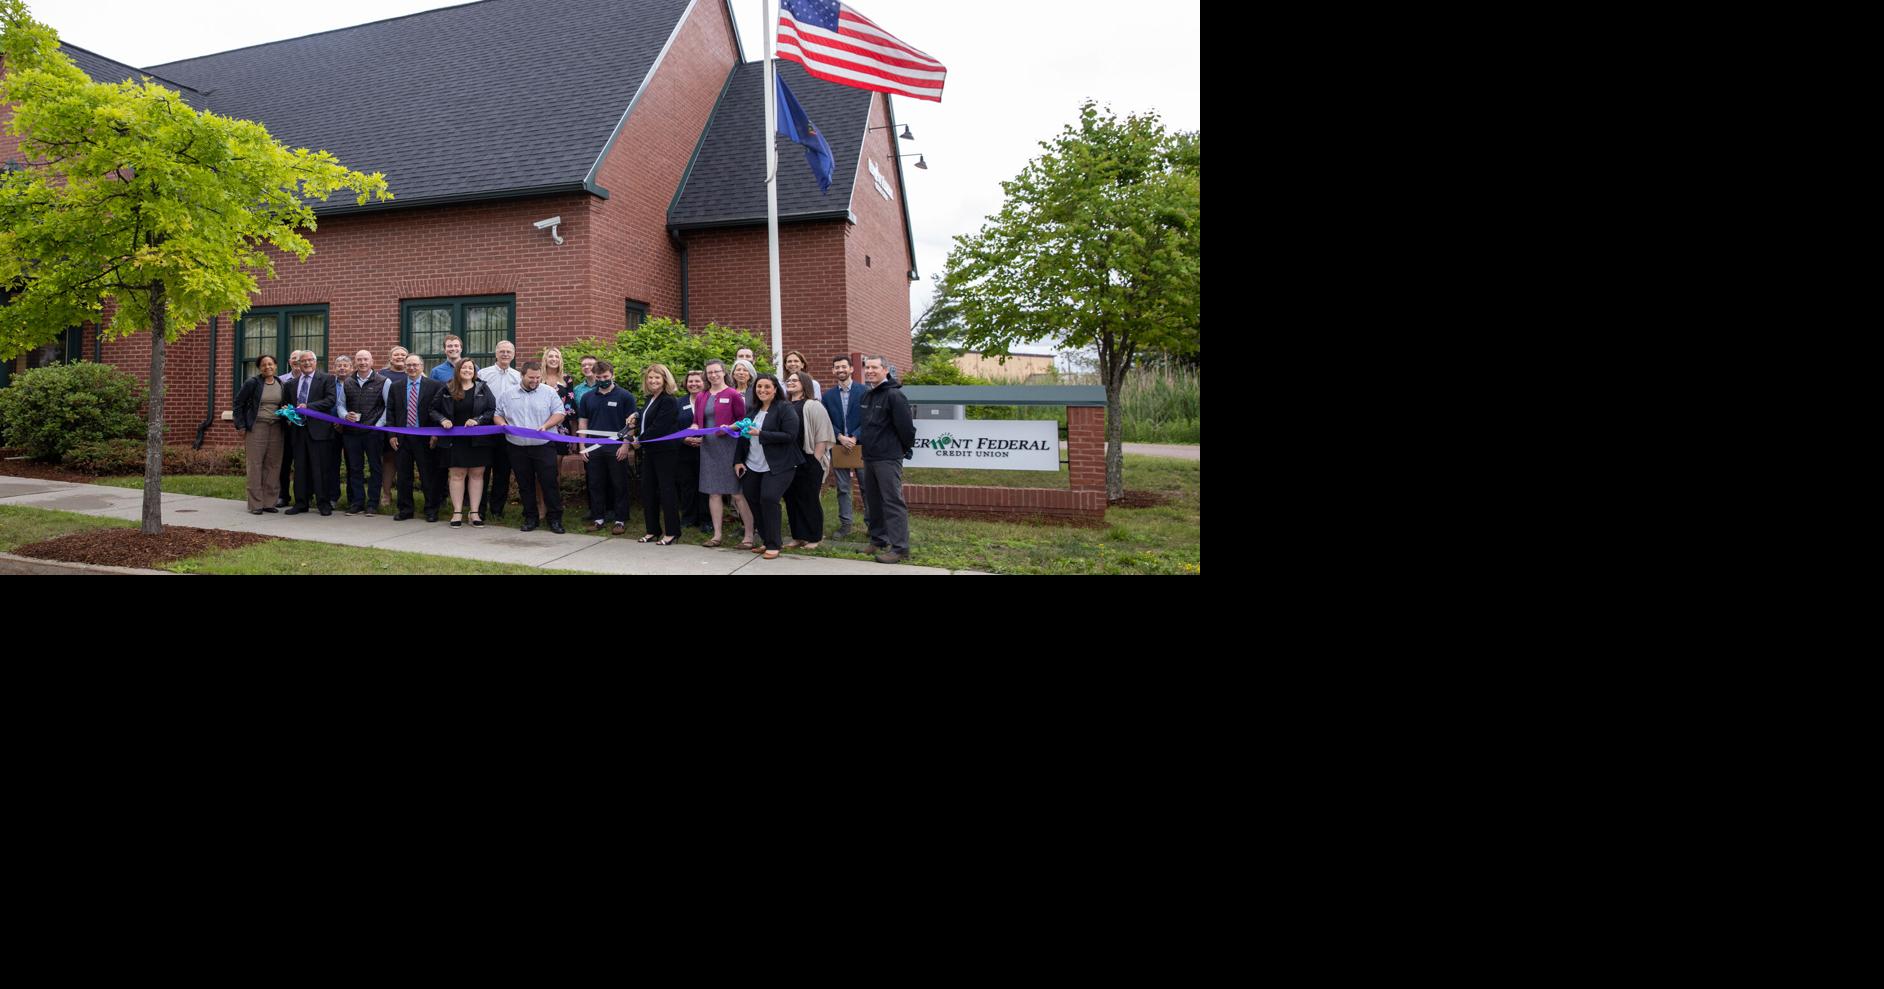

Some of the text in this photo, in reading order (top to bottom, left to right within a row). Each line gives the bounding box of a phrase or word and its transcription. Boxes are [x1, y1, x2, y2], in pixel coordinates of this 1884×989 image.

[913, 436, 1050, 451] ERMONT FEDERAL
[976, 450, 1010, 458] UNION
